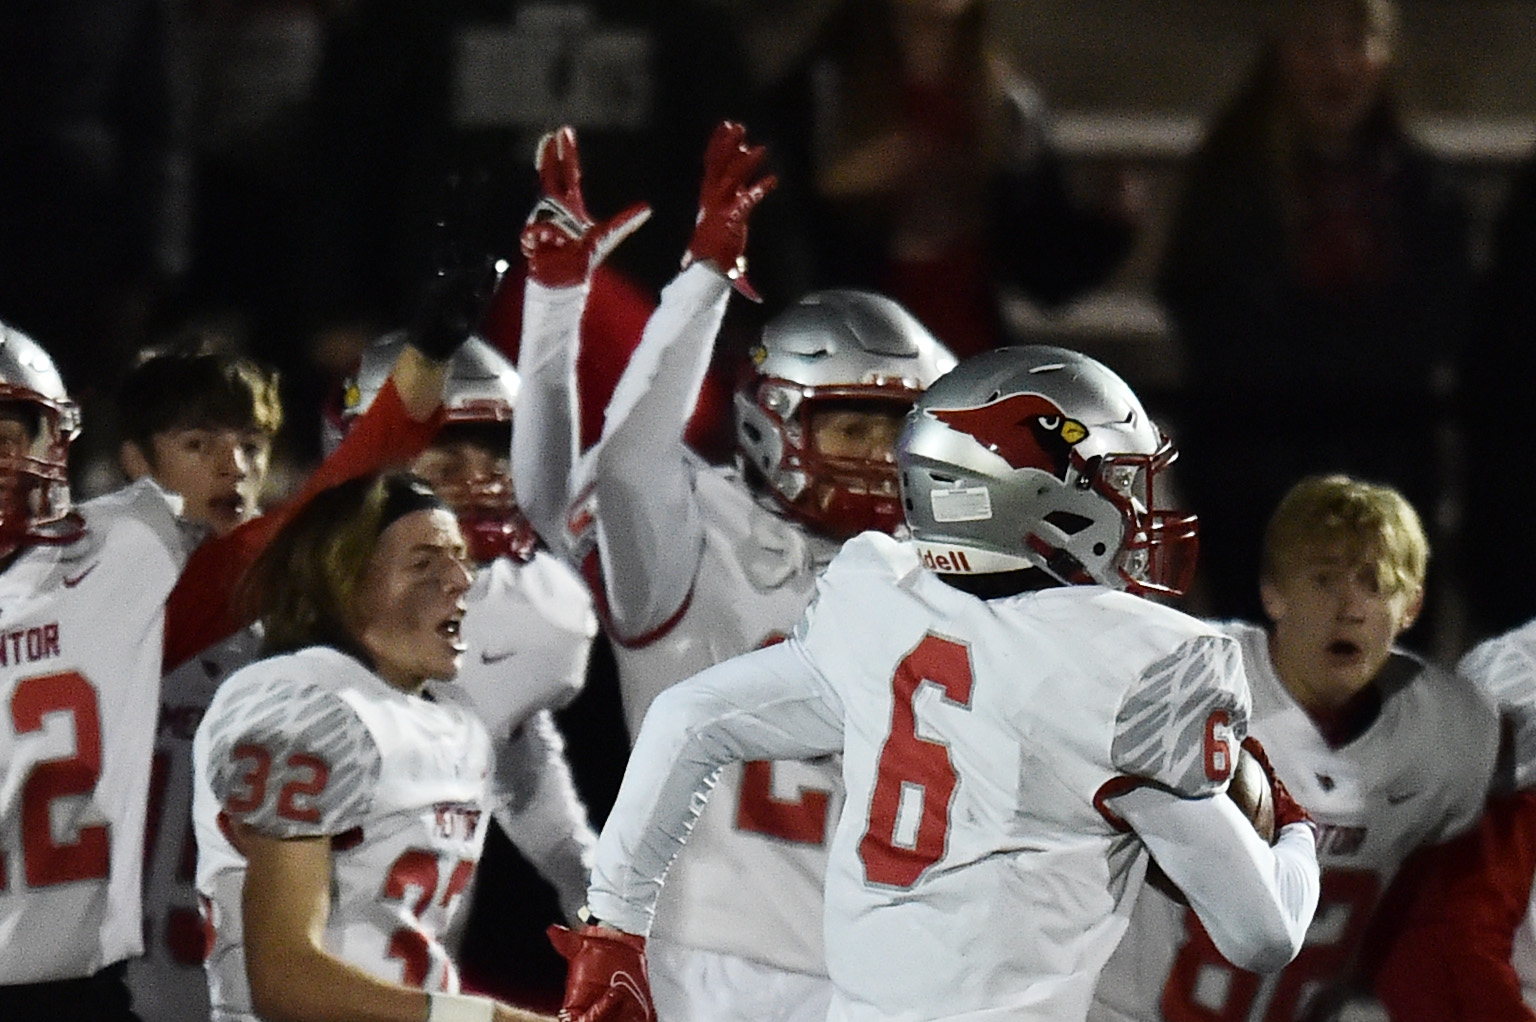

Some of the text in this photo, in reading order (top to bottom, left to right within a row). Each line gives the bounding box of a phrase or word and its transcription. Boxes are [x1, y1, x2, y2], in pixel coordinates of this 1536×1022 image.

[918, 548, 971, 571] dell
[227, 742, 329, 823] 32
[858, 629, 976, 891] 6
[1204, 710, 1231, 782] 6
